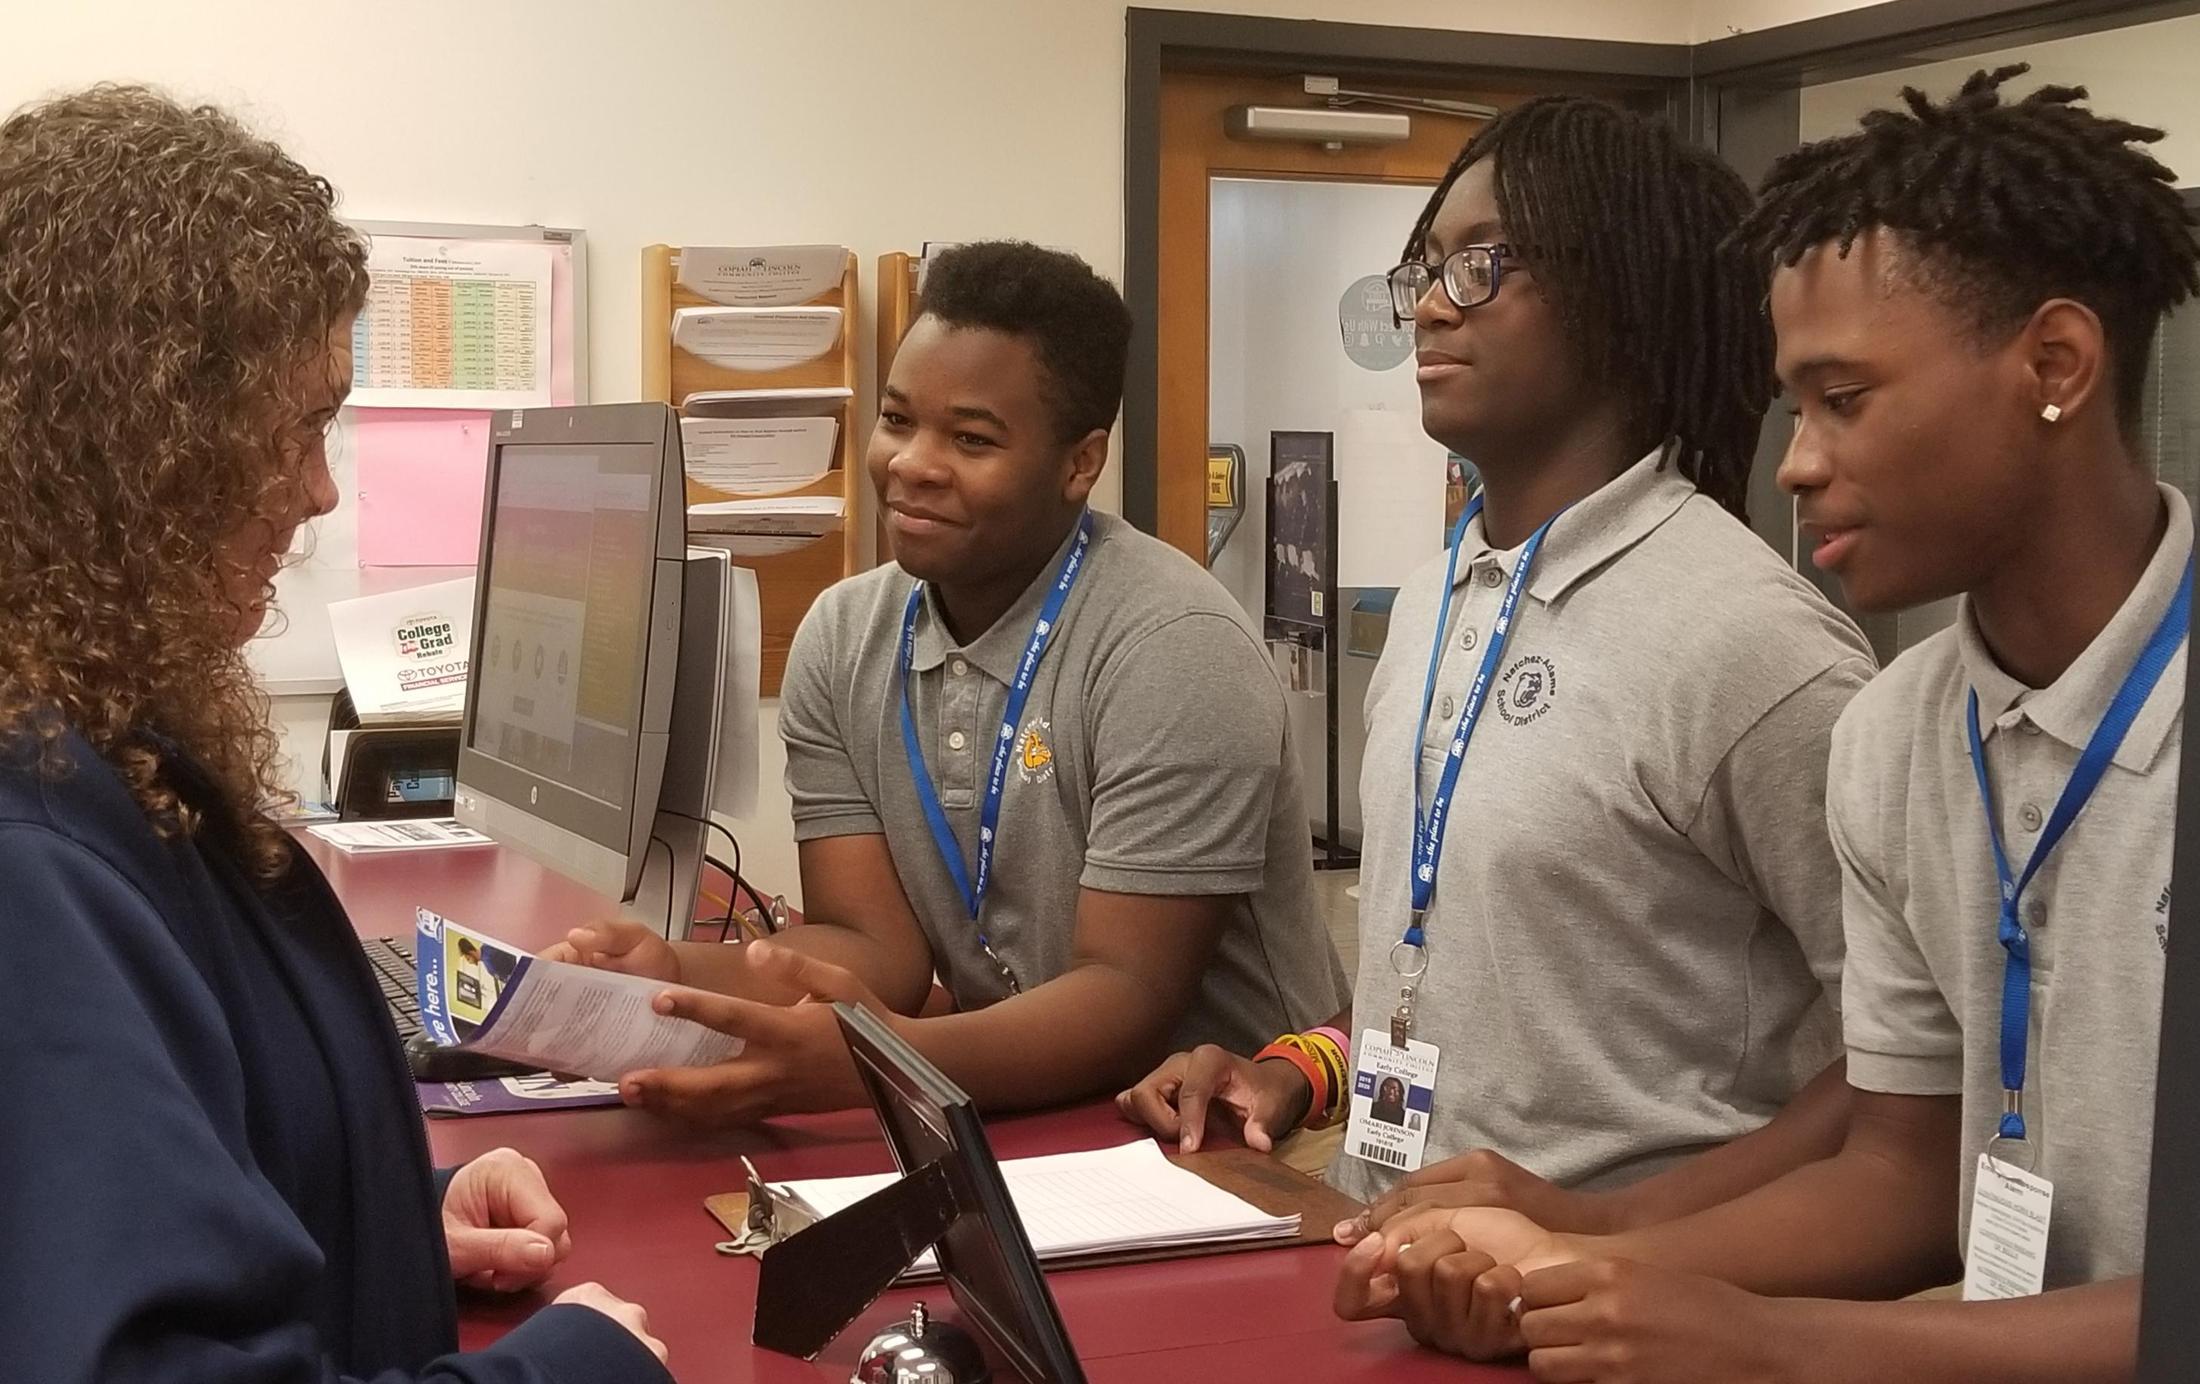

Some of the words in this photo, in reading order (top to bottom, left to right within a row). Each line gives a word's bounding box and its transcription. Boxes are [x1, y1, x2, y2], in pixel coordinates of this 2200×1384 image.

[397, 623, 451, 641] College
[419, 633, 453, 650] Grad
[416, 649, 443, 659] Rebate
[417, 660, 469, 678] TOYOTA
[1496, 688, 1515, 724] School
[1513, 702, 1552, 727] District
[1435, 797, 1445, 808] be
[1434, 808, 1442, 819] to
[1428, 818, 1440, 843] place
[423, 958, 442, 1017] here...
[1376, 1062, 1393, 1073] Early
[1394, 1065, 1419, 1079] College
[1360, 1118, 1383, 1130] OMARI
[1383, 1123, 1415, 1138] JOHNSON
[1367, 1127, 1381, 1137] Early
[1382, 1132, 1405, 1143] College
